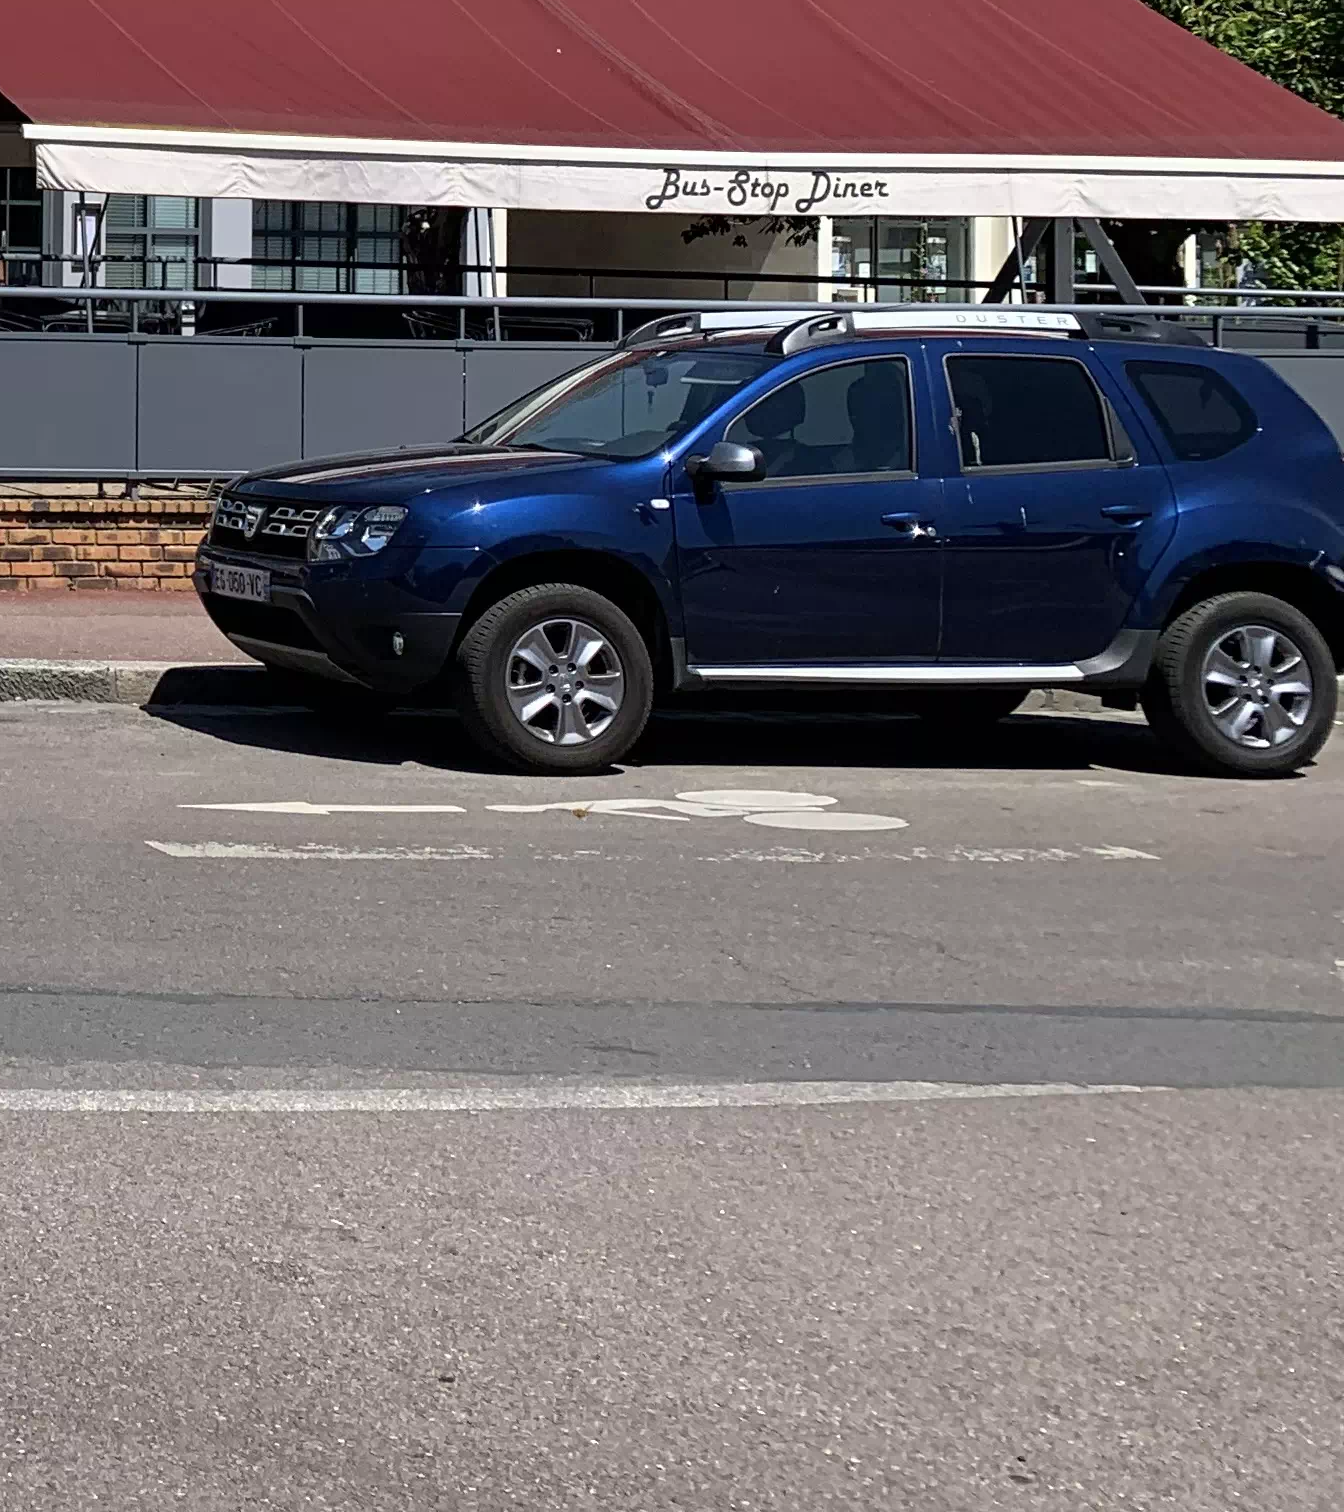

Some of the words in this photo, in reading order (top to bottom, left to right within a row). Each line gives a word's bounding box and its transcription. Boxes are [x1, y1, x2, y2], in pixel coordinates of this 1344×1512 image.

[645, 168, 789, 211] Bus-Stop
[795, 170, 889, 213] Diner
[956, 314, 1069, 326] DUSTER
